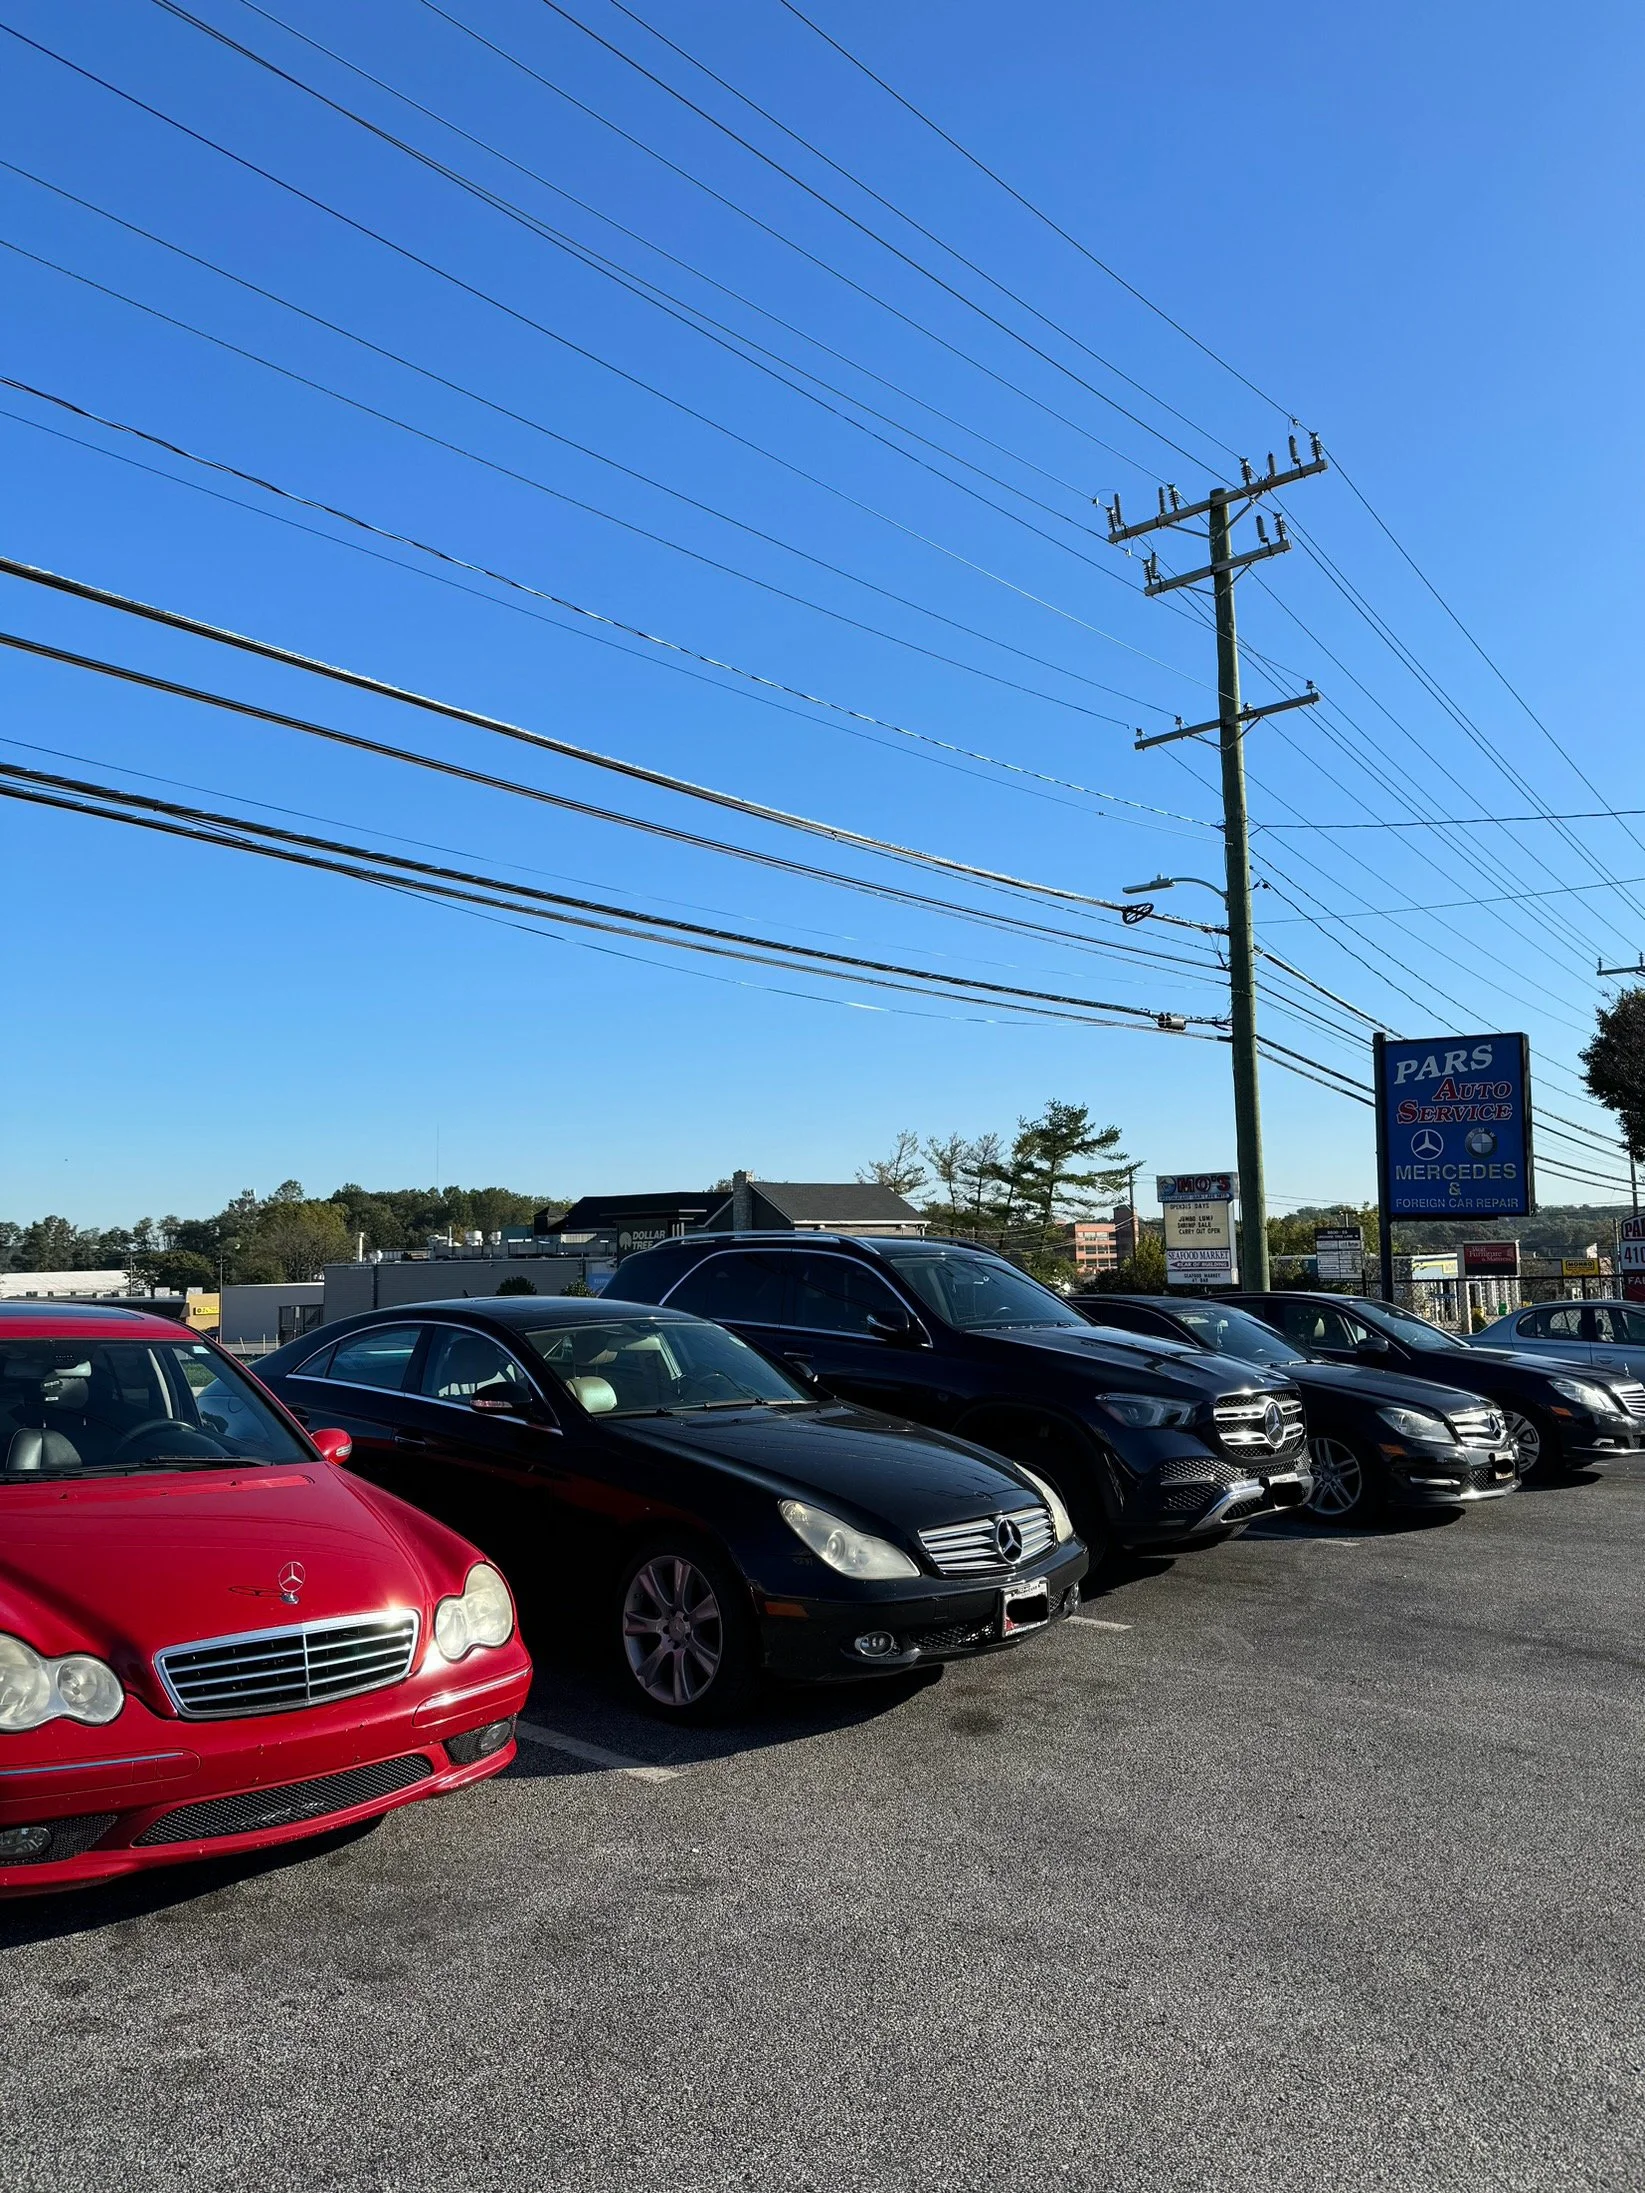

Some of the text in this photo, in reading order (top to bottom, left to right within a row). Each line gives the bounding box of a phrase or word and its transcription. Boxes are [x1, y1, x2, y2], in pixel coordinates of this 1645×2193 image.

[1394, 1044, 1493, 1085] PARS
[1432, 1077, 1512, 1101] AUTO
[1396, 1099, 1512, 1124] SERVICE
[1396, 1163, 1517, 1180] MERCEDES
[1177, 1175, 1231, 1193] MO'S
[1449, 1182, 1461, 1195] &
[1396, 1198, 1519, 1208] FOREIGN CAR REPAIR
[632, 1230, 666, 1240] DOLLAR
[632, 1241, 654, 1250] TREE
[1168, 1250, 1229, 1261] SEAFOOD MARKET
